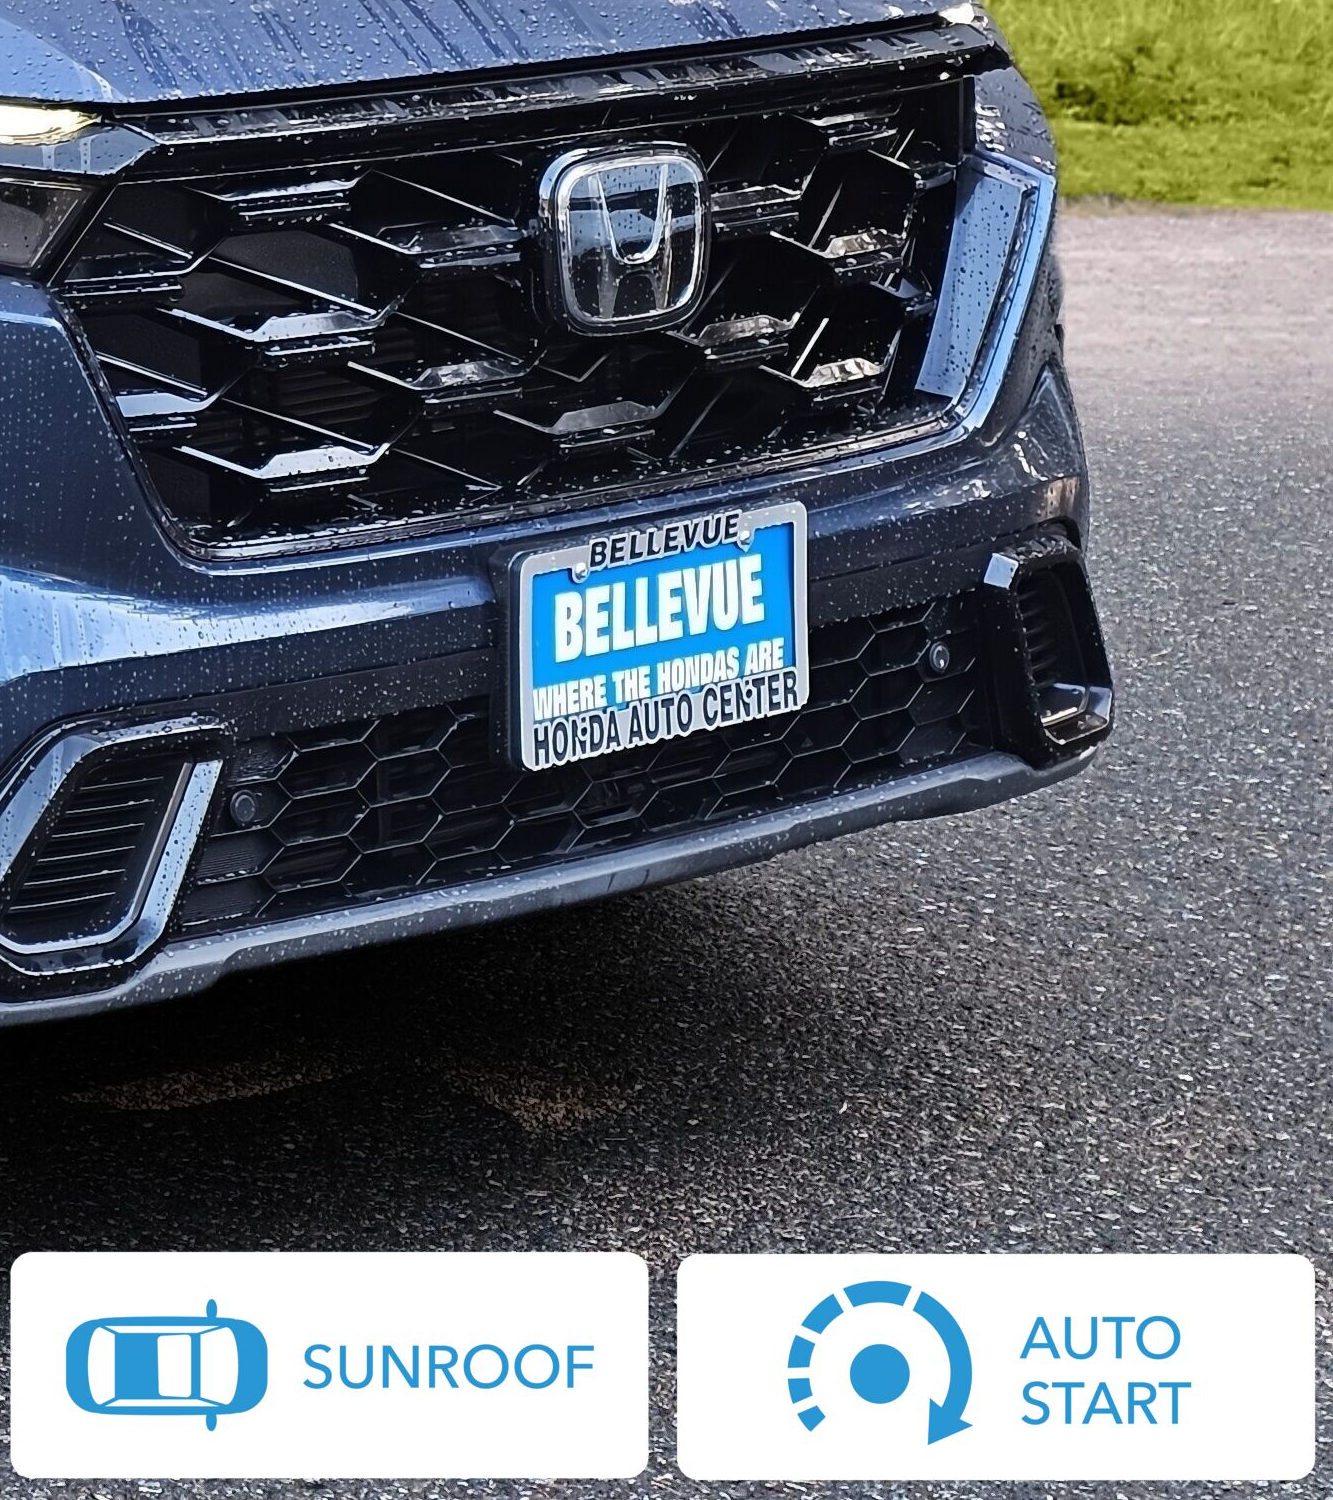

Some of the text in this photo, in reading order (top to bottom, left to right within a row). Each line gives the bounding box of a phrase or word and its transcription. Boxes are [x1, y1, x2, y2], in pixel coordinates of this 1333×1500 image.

[589, 511, 742, 568] BELLEVUE
[554, 553, 765, 663] BELLEVUE
[532, 637, 785, 721] WHERE THE HONDAS ARE
[533, 669, 799, 768] HONDA AUTO CENTER
